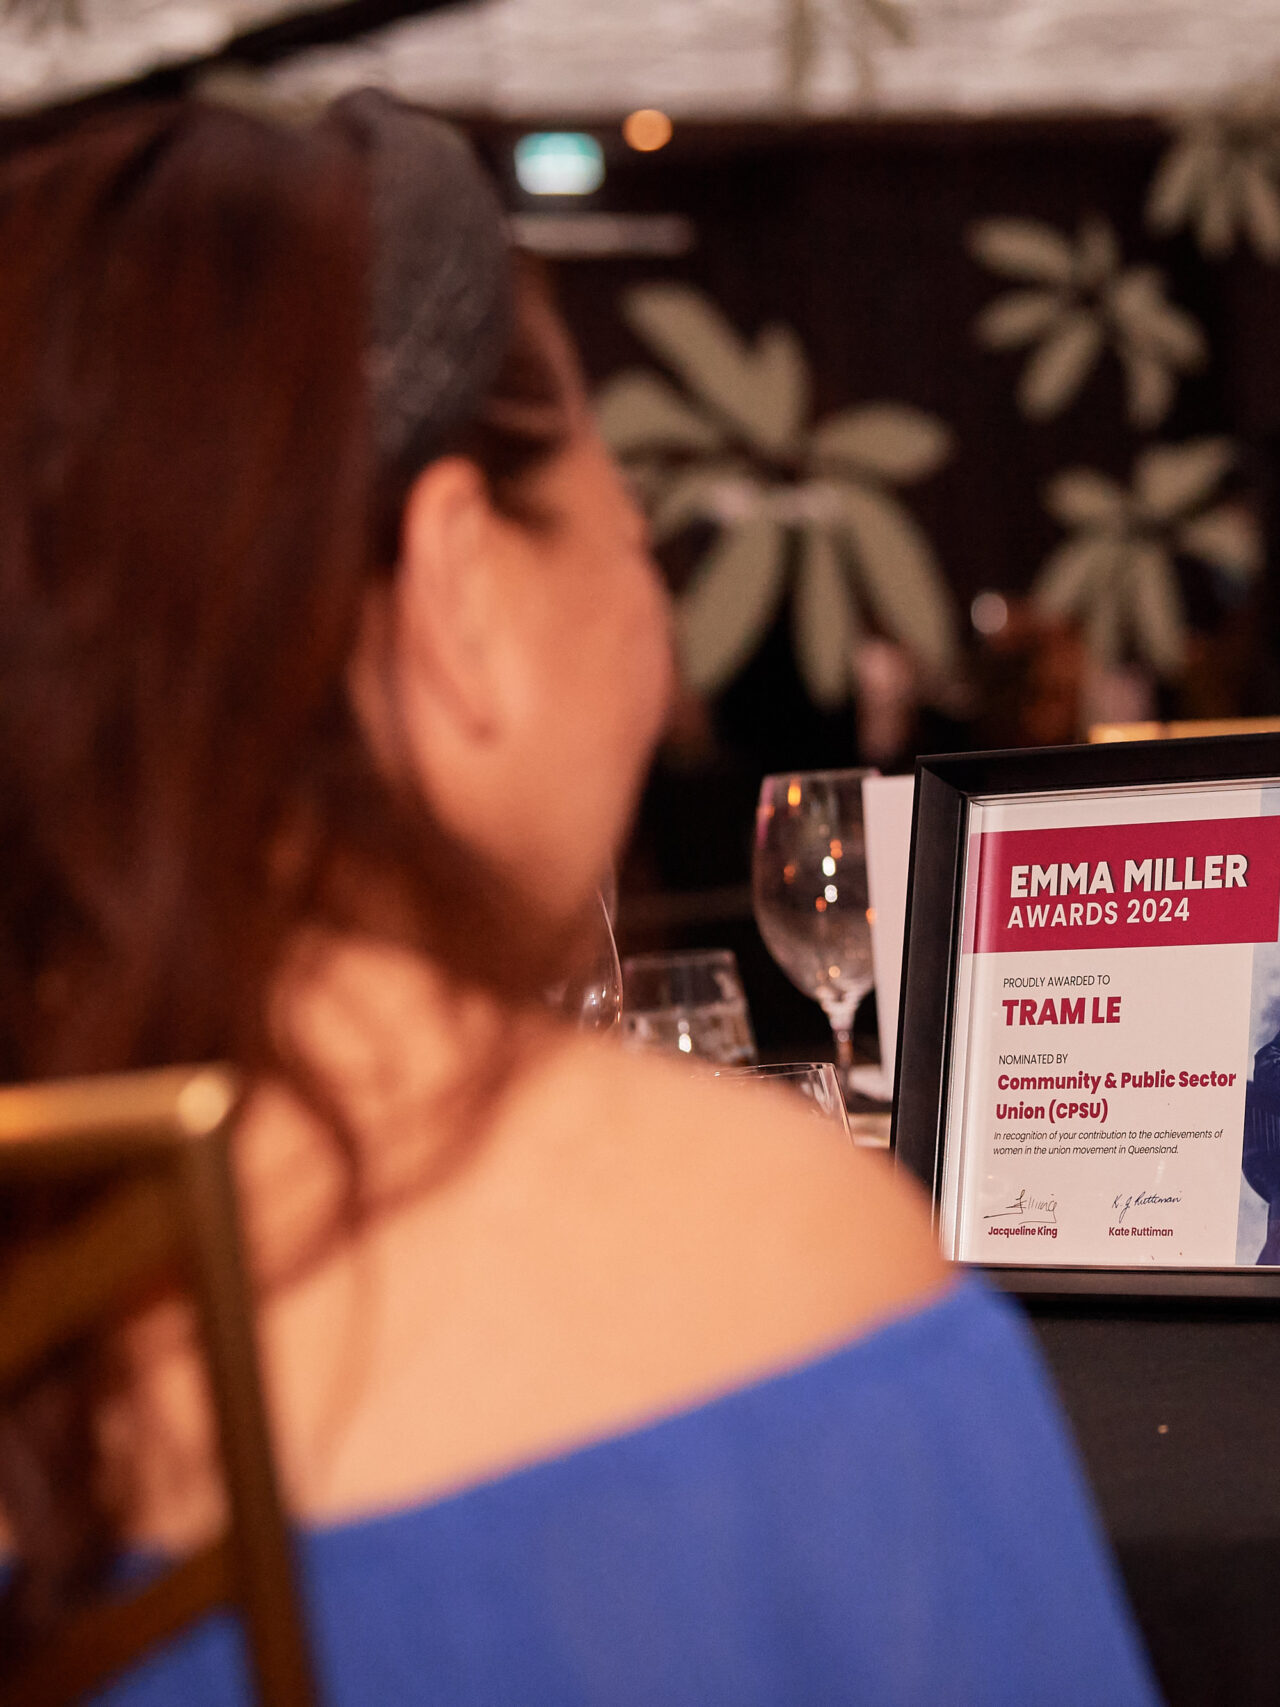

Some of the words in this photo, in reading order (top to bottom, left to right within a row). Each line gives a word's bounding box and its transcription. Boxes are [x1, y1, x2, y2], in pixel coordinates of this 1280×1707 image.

[1010, 860, 1115, 899] EMMA
[1122, 854, 1249, 894] MILLER
[1007, 901, 1119, 929] AWARDS
[1126, 897, 1190, 924] 2024
[1003, 977, 1046, 988] PROUDLY
[1047, 976, 1095, 987] AWARDED
[1096, 974, 1111, 986] TO
[1002, 997, 1086, 1026] TRAM
[1091, 996, 1122, 1024] LE
[998, 1054, 1054, 1065] NOMINATED
[1056, 1053, 1069, 1064] BY
[997, 1071, 1102, 1094] Community
[1104, 1072, 1117, 1089] &
[1120, 1069, 1175, 1089] Public
[1178, 1069, 1237, 1088] Sector
[996, 1101, 1046, 1120] Union
[1049, 1098, 1108, 1124] (CPSU)
[993, 1131, 1001, 1140] In
[1002, 1130, 1048, 1142] recognition
[1049, 1130, 1058, 1140] of
[1059, 1131, 1077, 1142] your
[1078, 1129, 1127, 1140] contribution
[1128, 1130, 1137, 1139] to
[1138, 1129, 1152, 1139] the
[1153, 1128, 1213, 1140] achievements
[1214, 1128, 1224, 1139] of
[993, 1146, 1023, 1155] women
[1024, 1145, 1032, 1155] in
[1033, 1145, 1047, 1155] the
[1048, 1145, 1071, 1155] union
[1072, 1145, 1117, 1155] movement
[1118, 1144, 1126, 1154] in
[1127, 1144, 1179, 1155] Queensland.
[988, 1226, 1036, 1238] Jacqueline
[1037, 1226, 1058, 1239] King
[1108, 1226, 1129, 1237] Kate
[1131, 1226, 1174, 1237] Ruttiman
